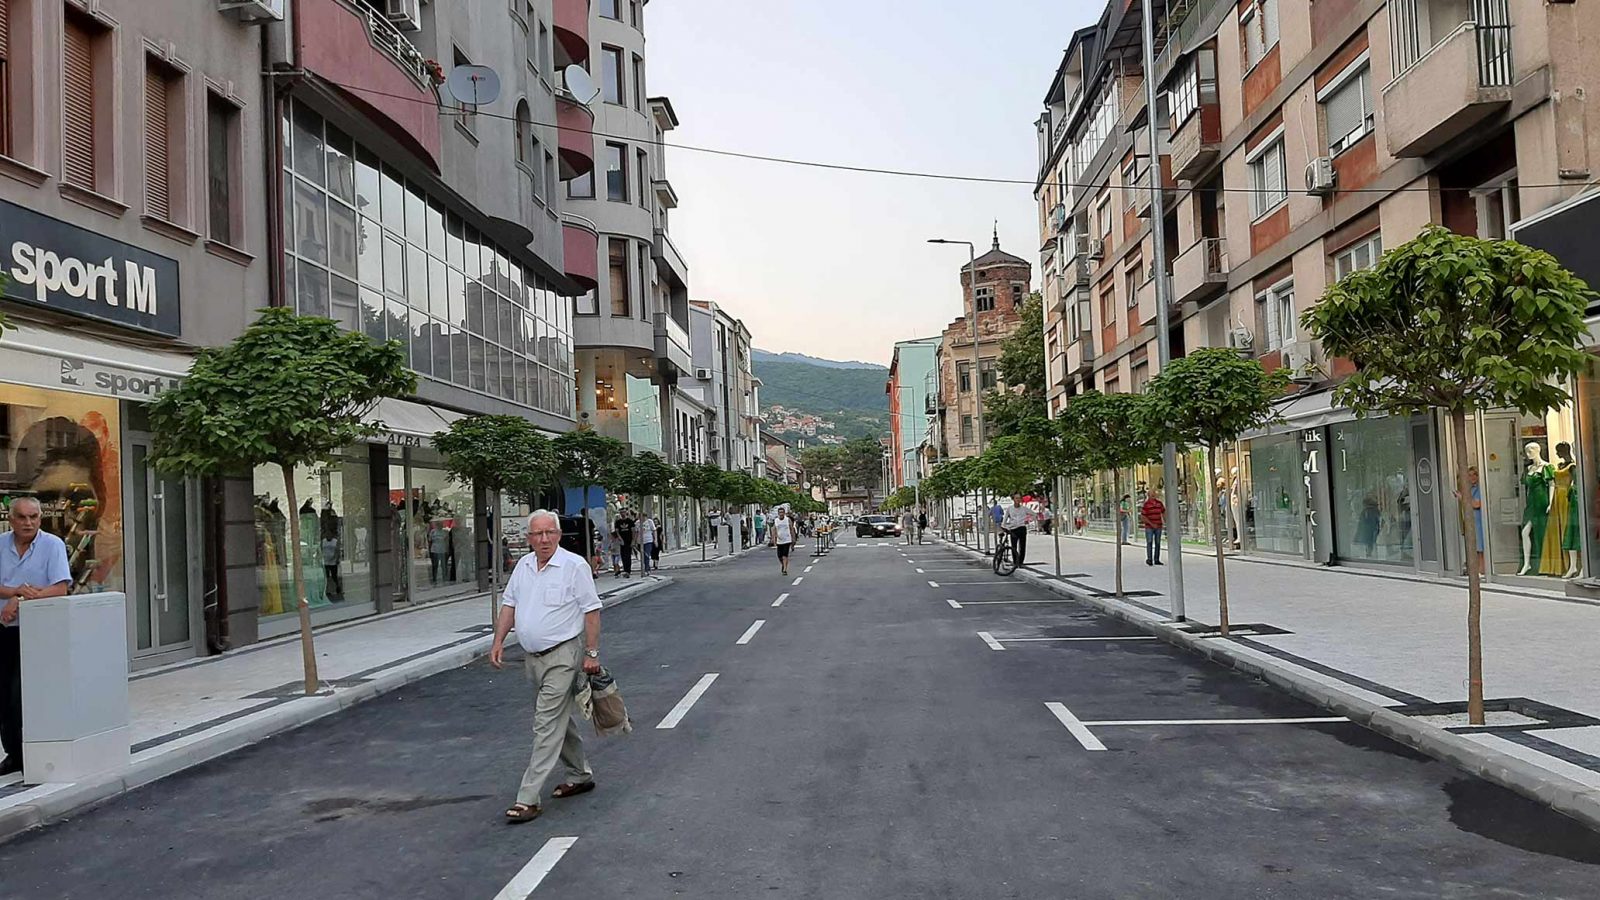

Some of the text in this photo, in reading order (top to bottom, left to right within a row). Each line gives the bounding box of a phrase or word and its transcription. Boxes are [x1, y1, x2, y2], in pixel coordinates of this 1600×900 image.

[11, 241, 157, 315] sport M
[95, 371, 163, 395] sport
[388, 433, 421, 448] ALBA
